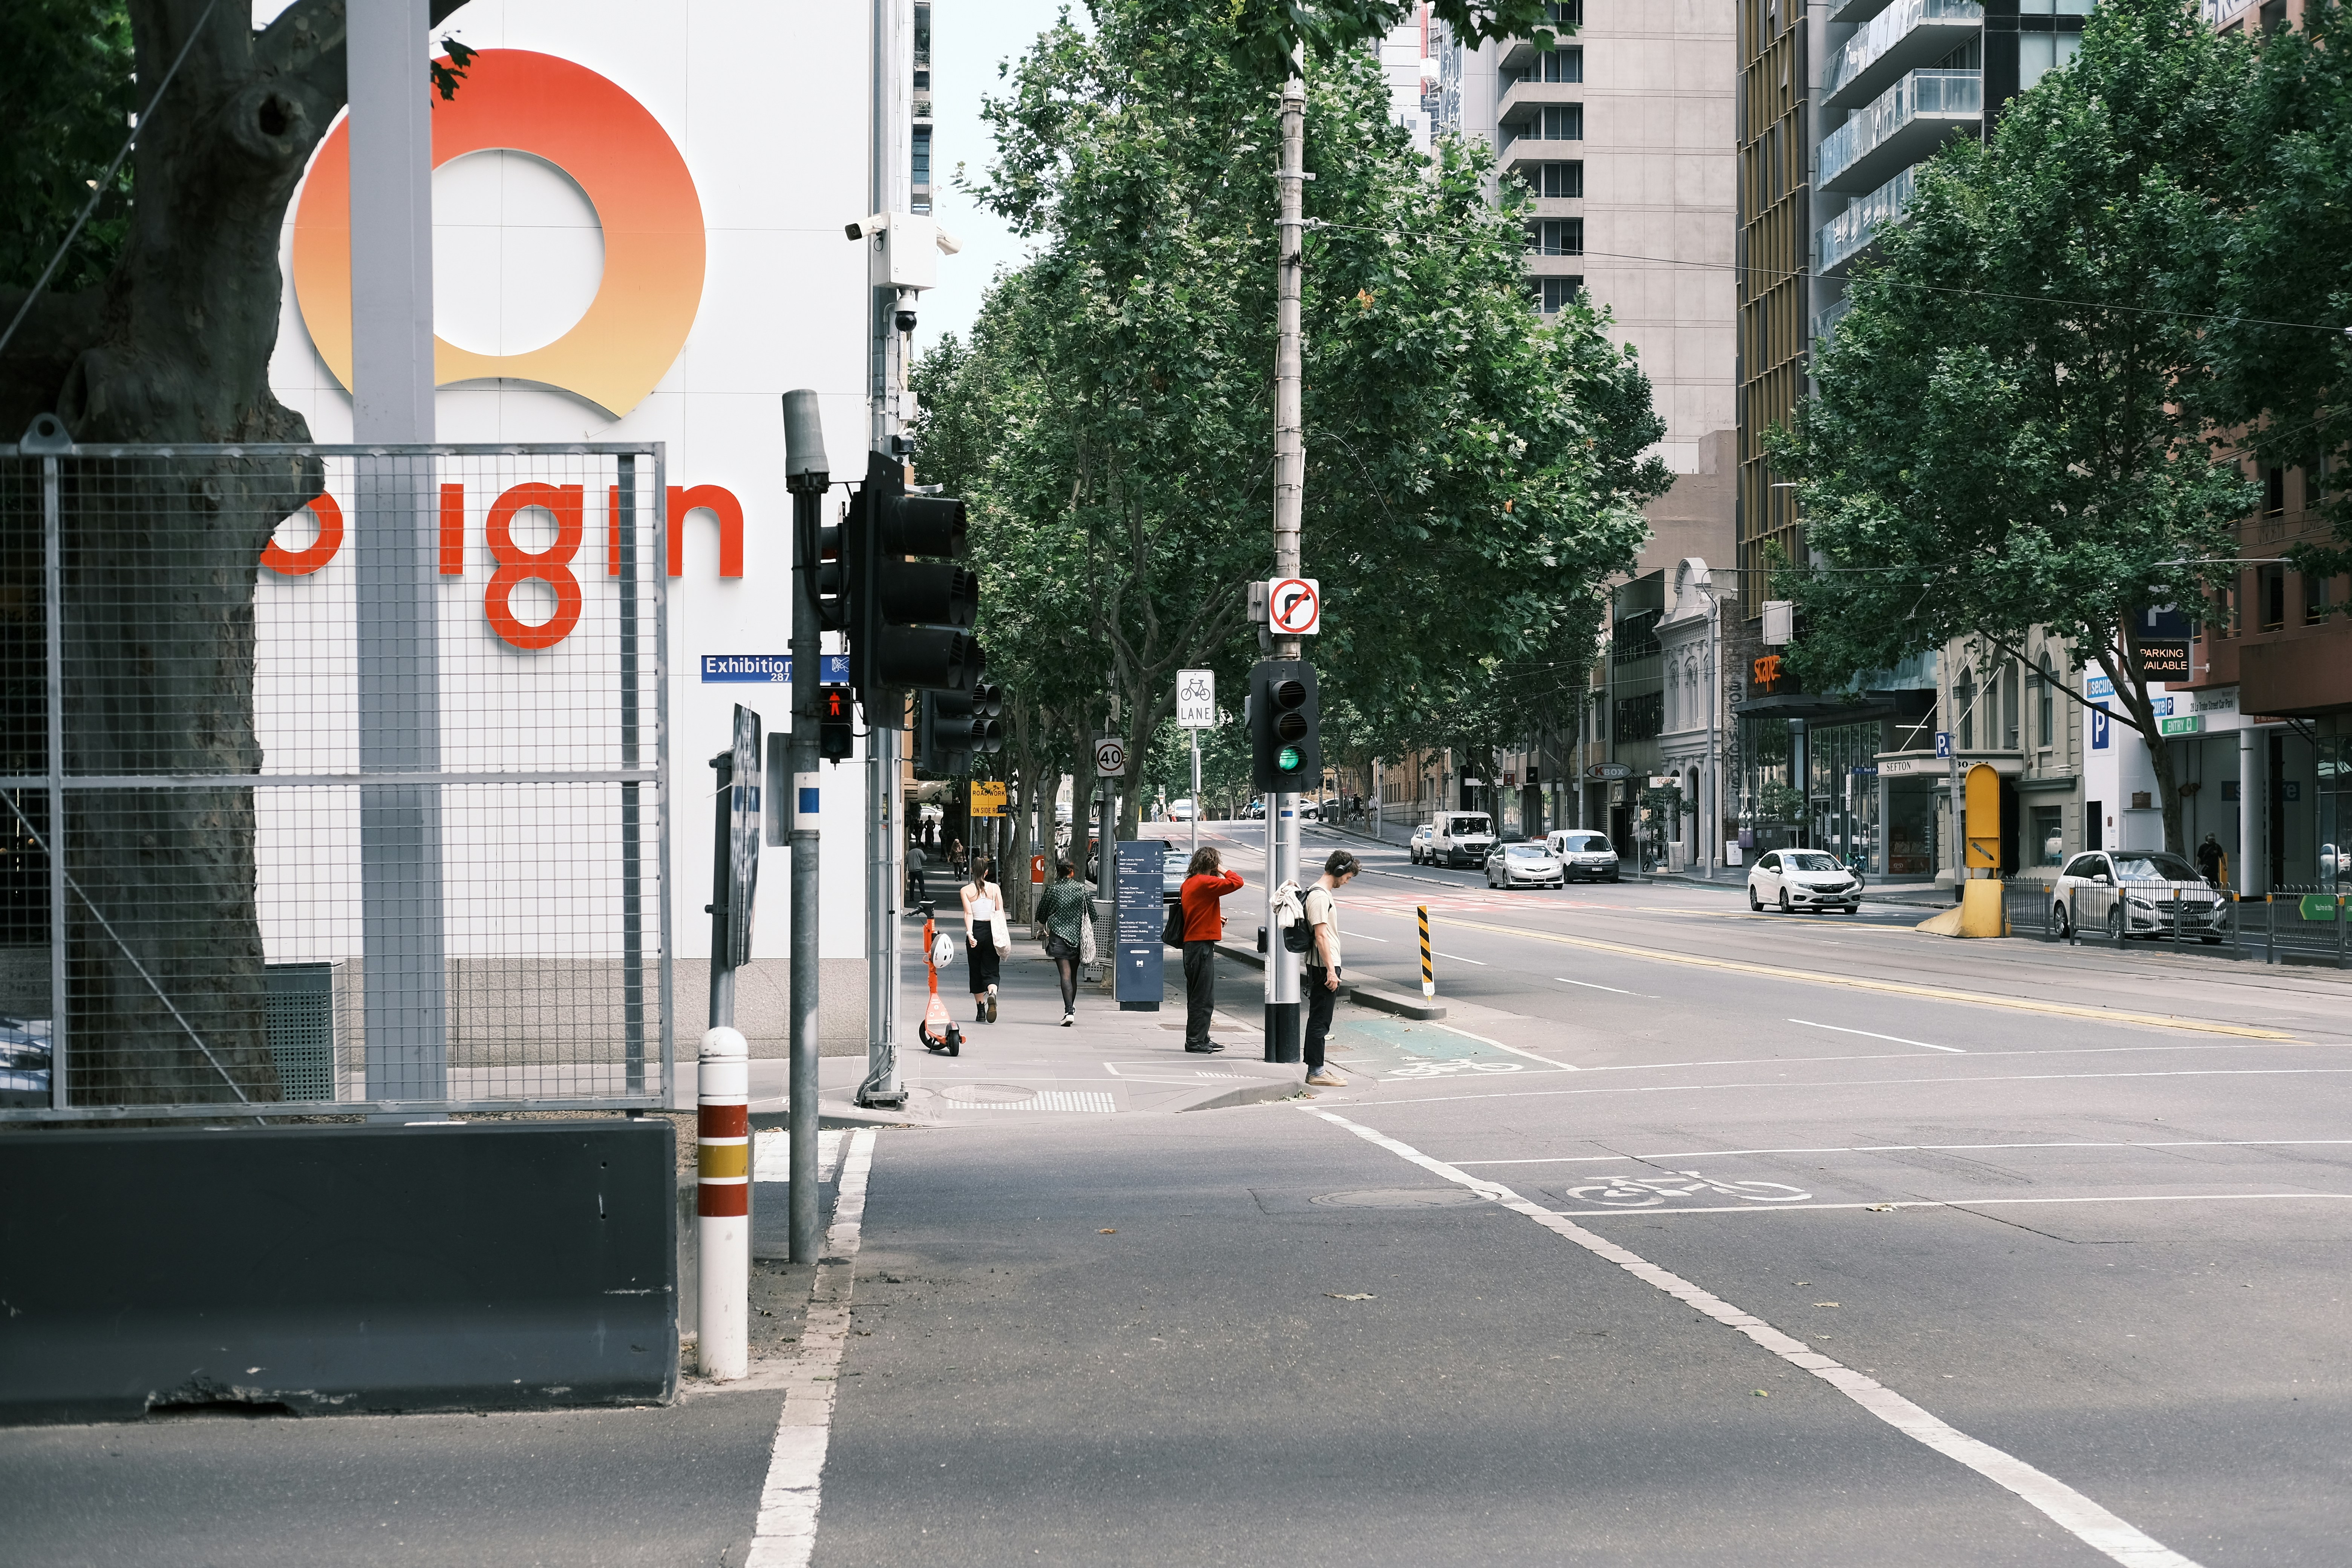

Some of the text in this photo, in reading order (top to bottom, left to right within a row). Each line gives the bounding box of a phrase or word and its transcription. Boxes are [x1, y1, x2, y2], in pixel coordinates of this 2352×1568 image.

[260, 482, 743, 650] oigin
[2140, 649, 2184, 658] PARKING
[706, 657, 792, 673] Exhibition
[2144, 661, 2188, 670] VAILABLE
[2092, 680, 2114, 695] secure
[2153, 700, 2165, 714] cure
[2190, 703, 2194, 712] 28
[2195, 703, 2199, 711] La
[2199, 702, 2208, 711] Trobe
[2208, 700, 2218, 710] Street
[1181, 707, 1211, 720] LANE
[2096, 710, 2105, 742] P
[2167, 720, 2184, 732] ENTRY
[1938, 735, 1946, 754] P
[1100, 750, 1121, 764] 40
[1886, 761, 1911, 772] SEFTON
